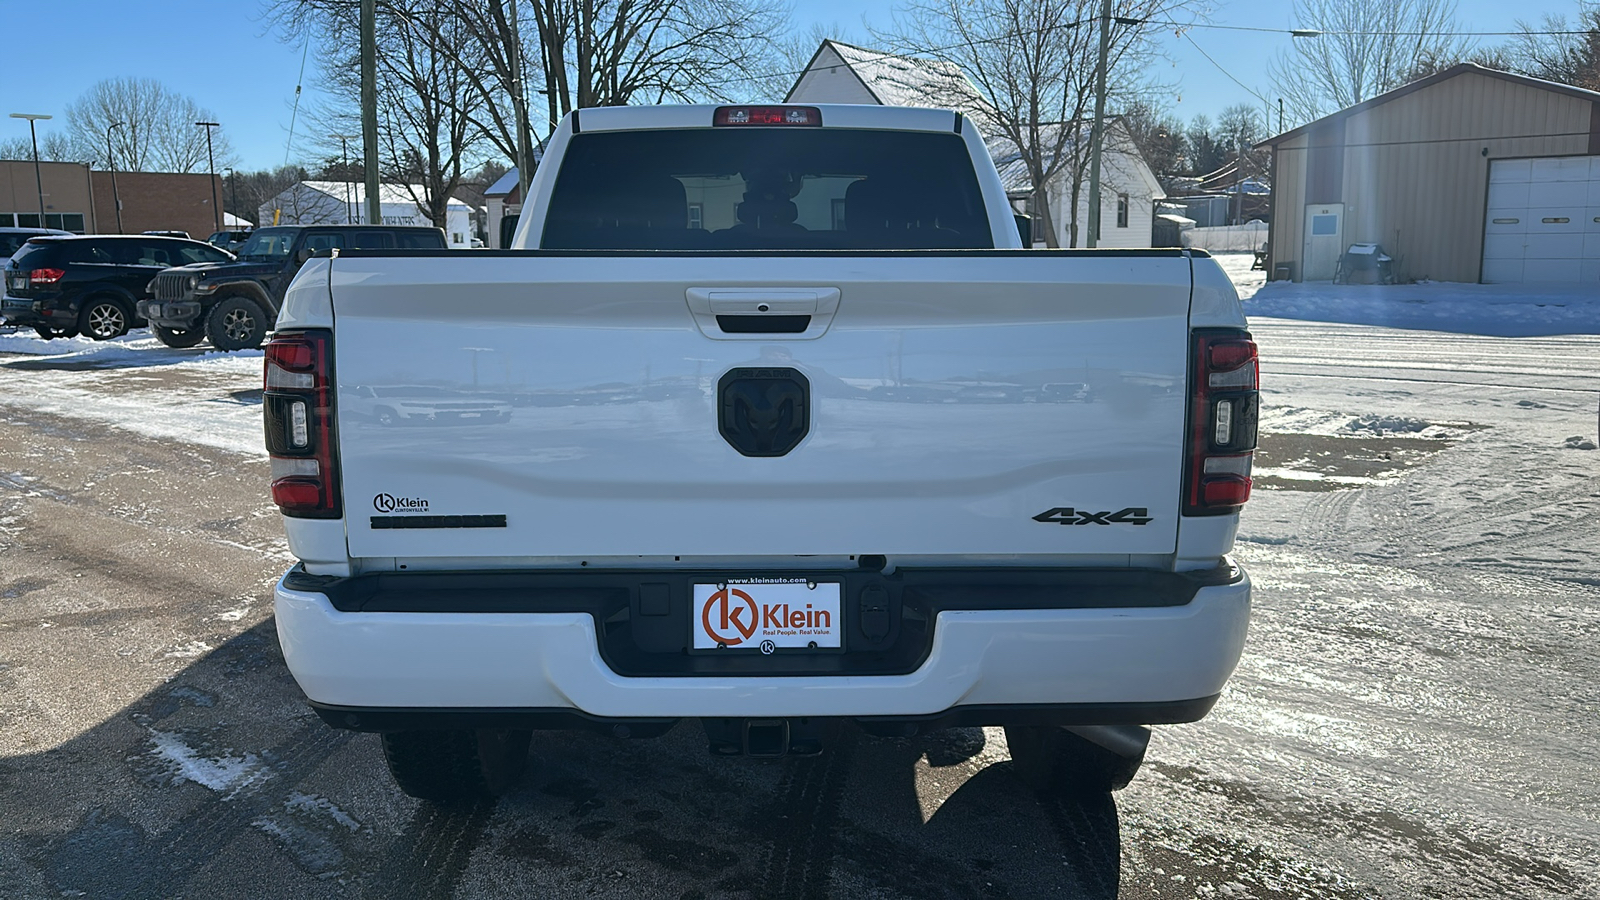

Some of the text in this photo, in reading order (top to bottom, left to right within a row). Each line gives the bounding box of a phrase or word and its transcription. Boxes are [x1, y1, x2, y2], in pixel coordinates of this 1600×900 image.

[736, 369, 791, 378] RAM
[396, 497, 429, 508] Klein
[1031, 507, 1154, 525] 4x4
[762, 603, 831, 629] Klein
